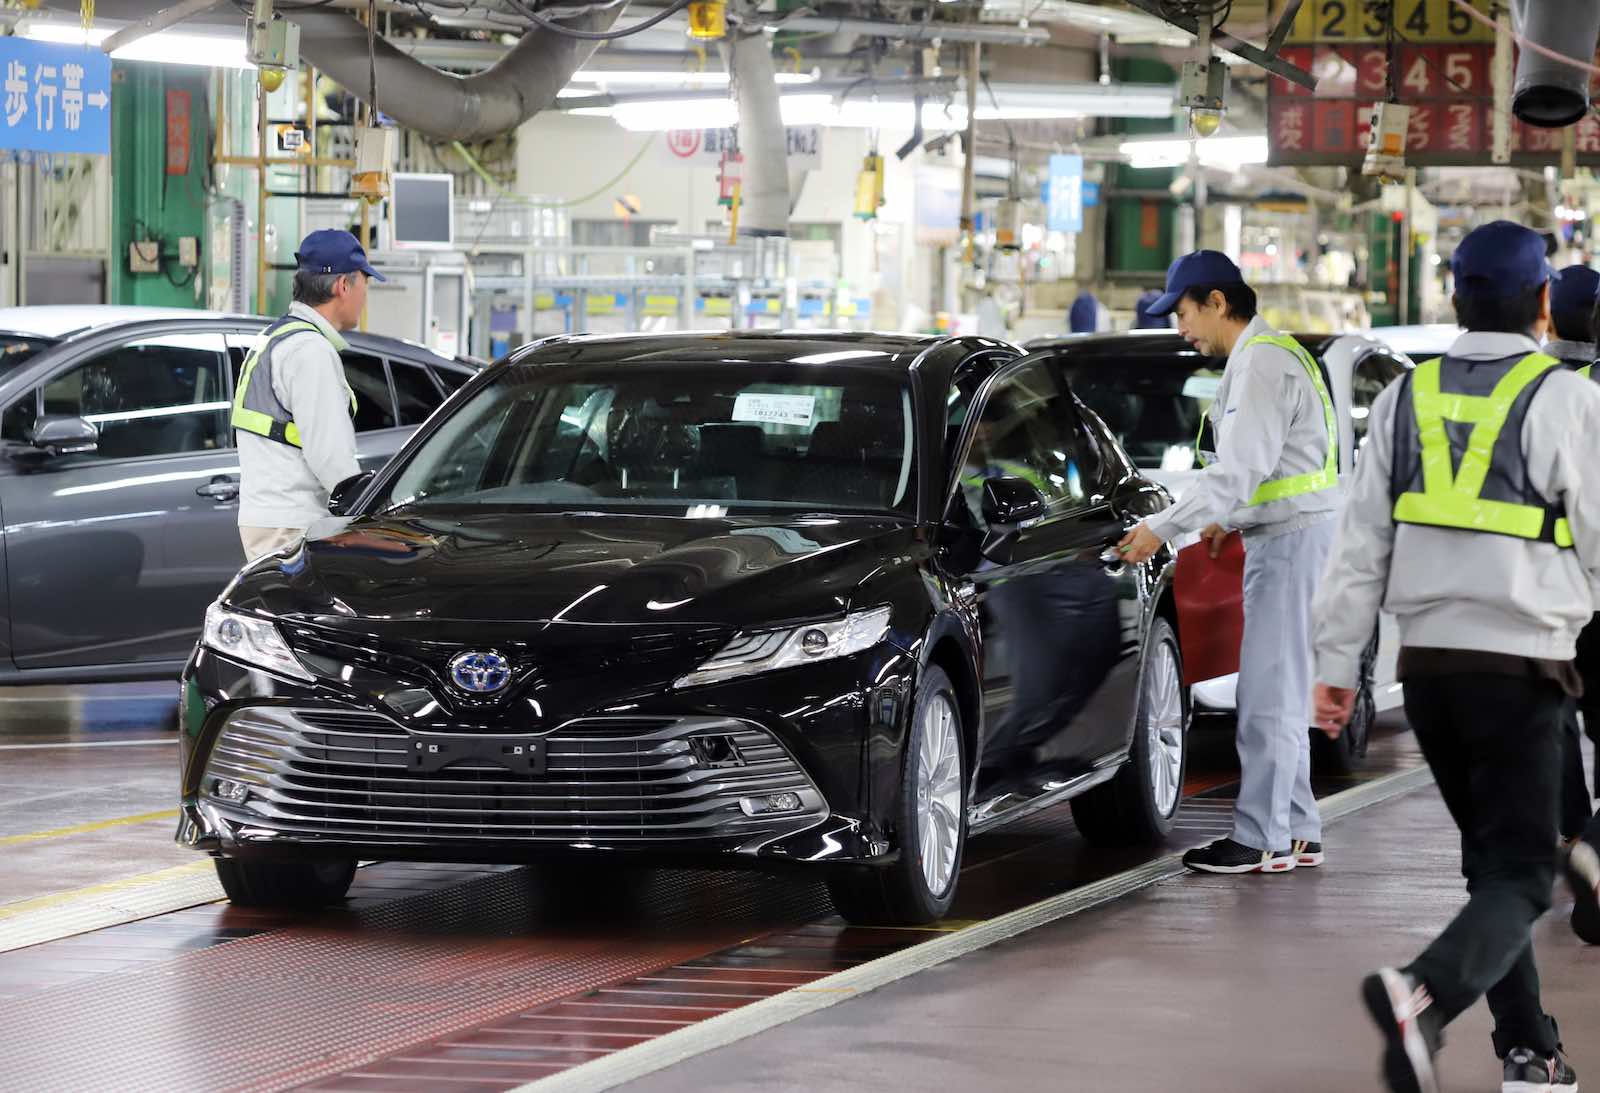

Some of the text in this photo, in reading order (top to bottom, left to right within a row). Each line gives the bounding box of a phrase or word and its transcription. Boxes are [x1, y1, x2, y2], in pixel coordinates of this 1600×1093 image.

[1321, 1, 1346, 36] 2
[1405, 0, 1430, 35] 4
[1361, 51, 1387, 91] 3
[1404, 56, 1430, 93] 4
[1446, 53, 1473, 92] 5
[4, 60, 84, 131] 歩行帯
